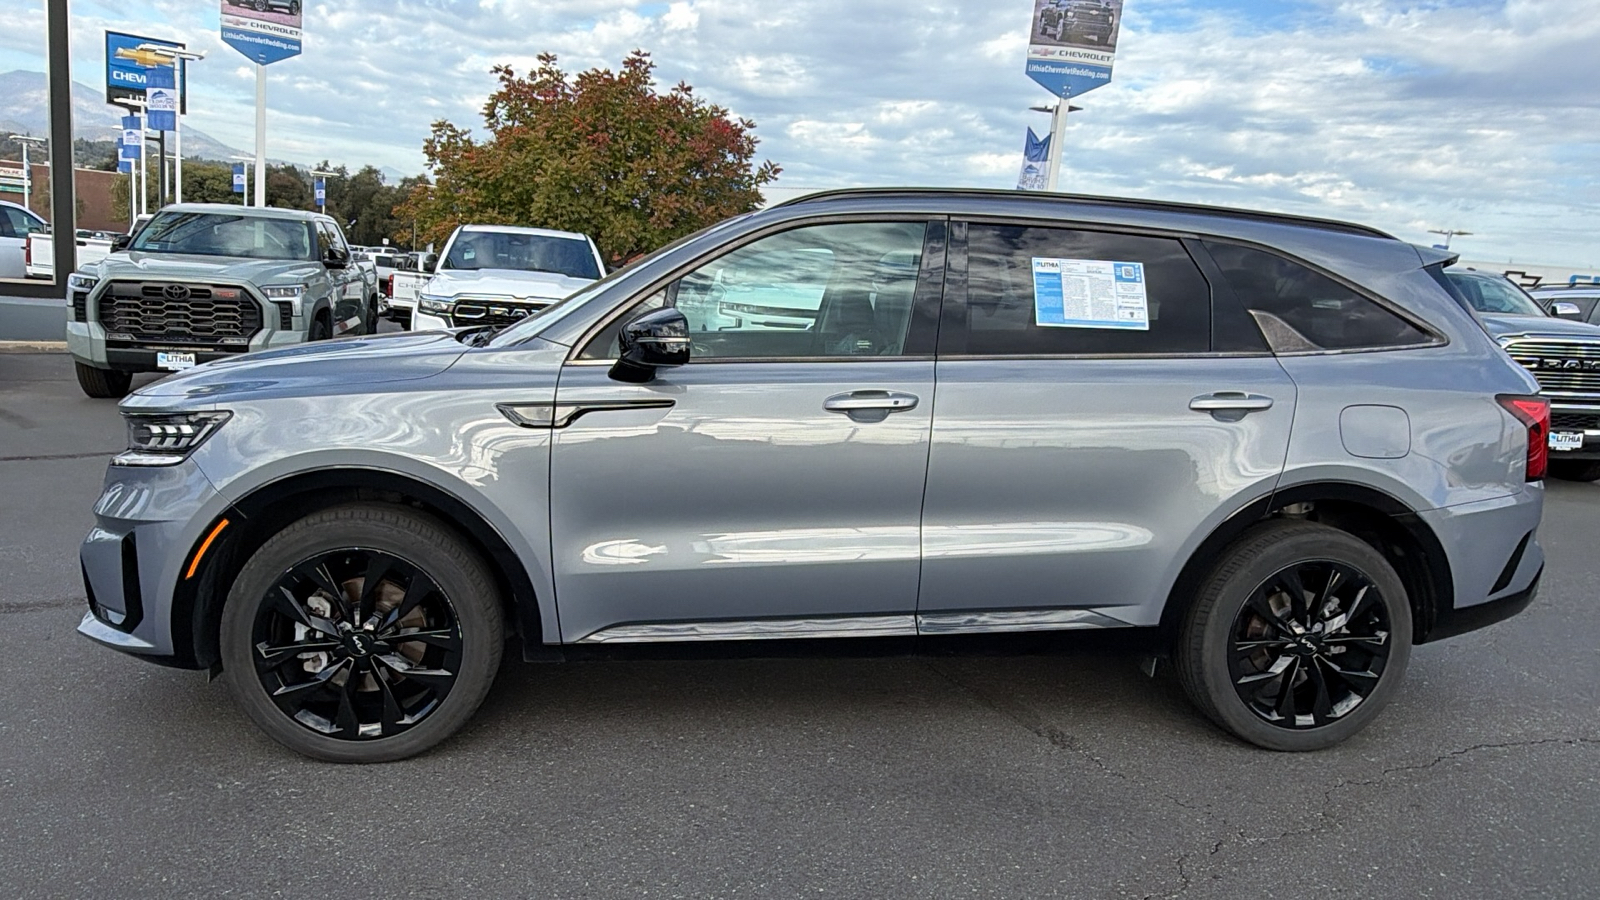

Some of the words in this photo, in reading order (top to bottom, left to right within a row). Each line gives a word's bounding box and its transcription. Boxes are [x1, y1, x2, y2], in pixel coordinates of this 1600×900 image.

[250, 21, 300, 36] CHEVROLET
[223, 31, 300, 51] LithiaChevroletRedding.com
[1058, 50, 1112, 62] CHEVROLET
[1028, 65, 1109, 79] LithiaChevroletRedding.com
[166, 355, 194, 363] LITHIA
[1556, 435, 1581, 443] LITHIA
